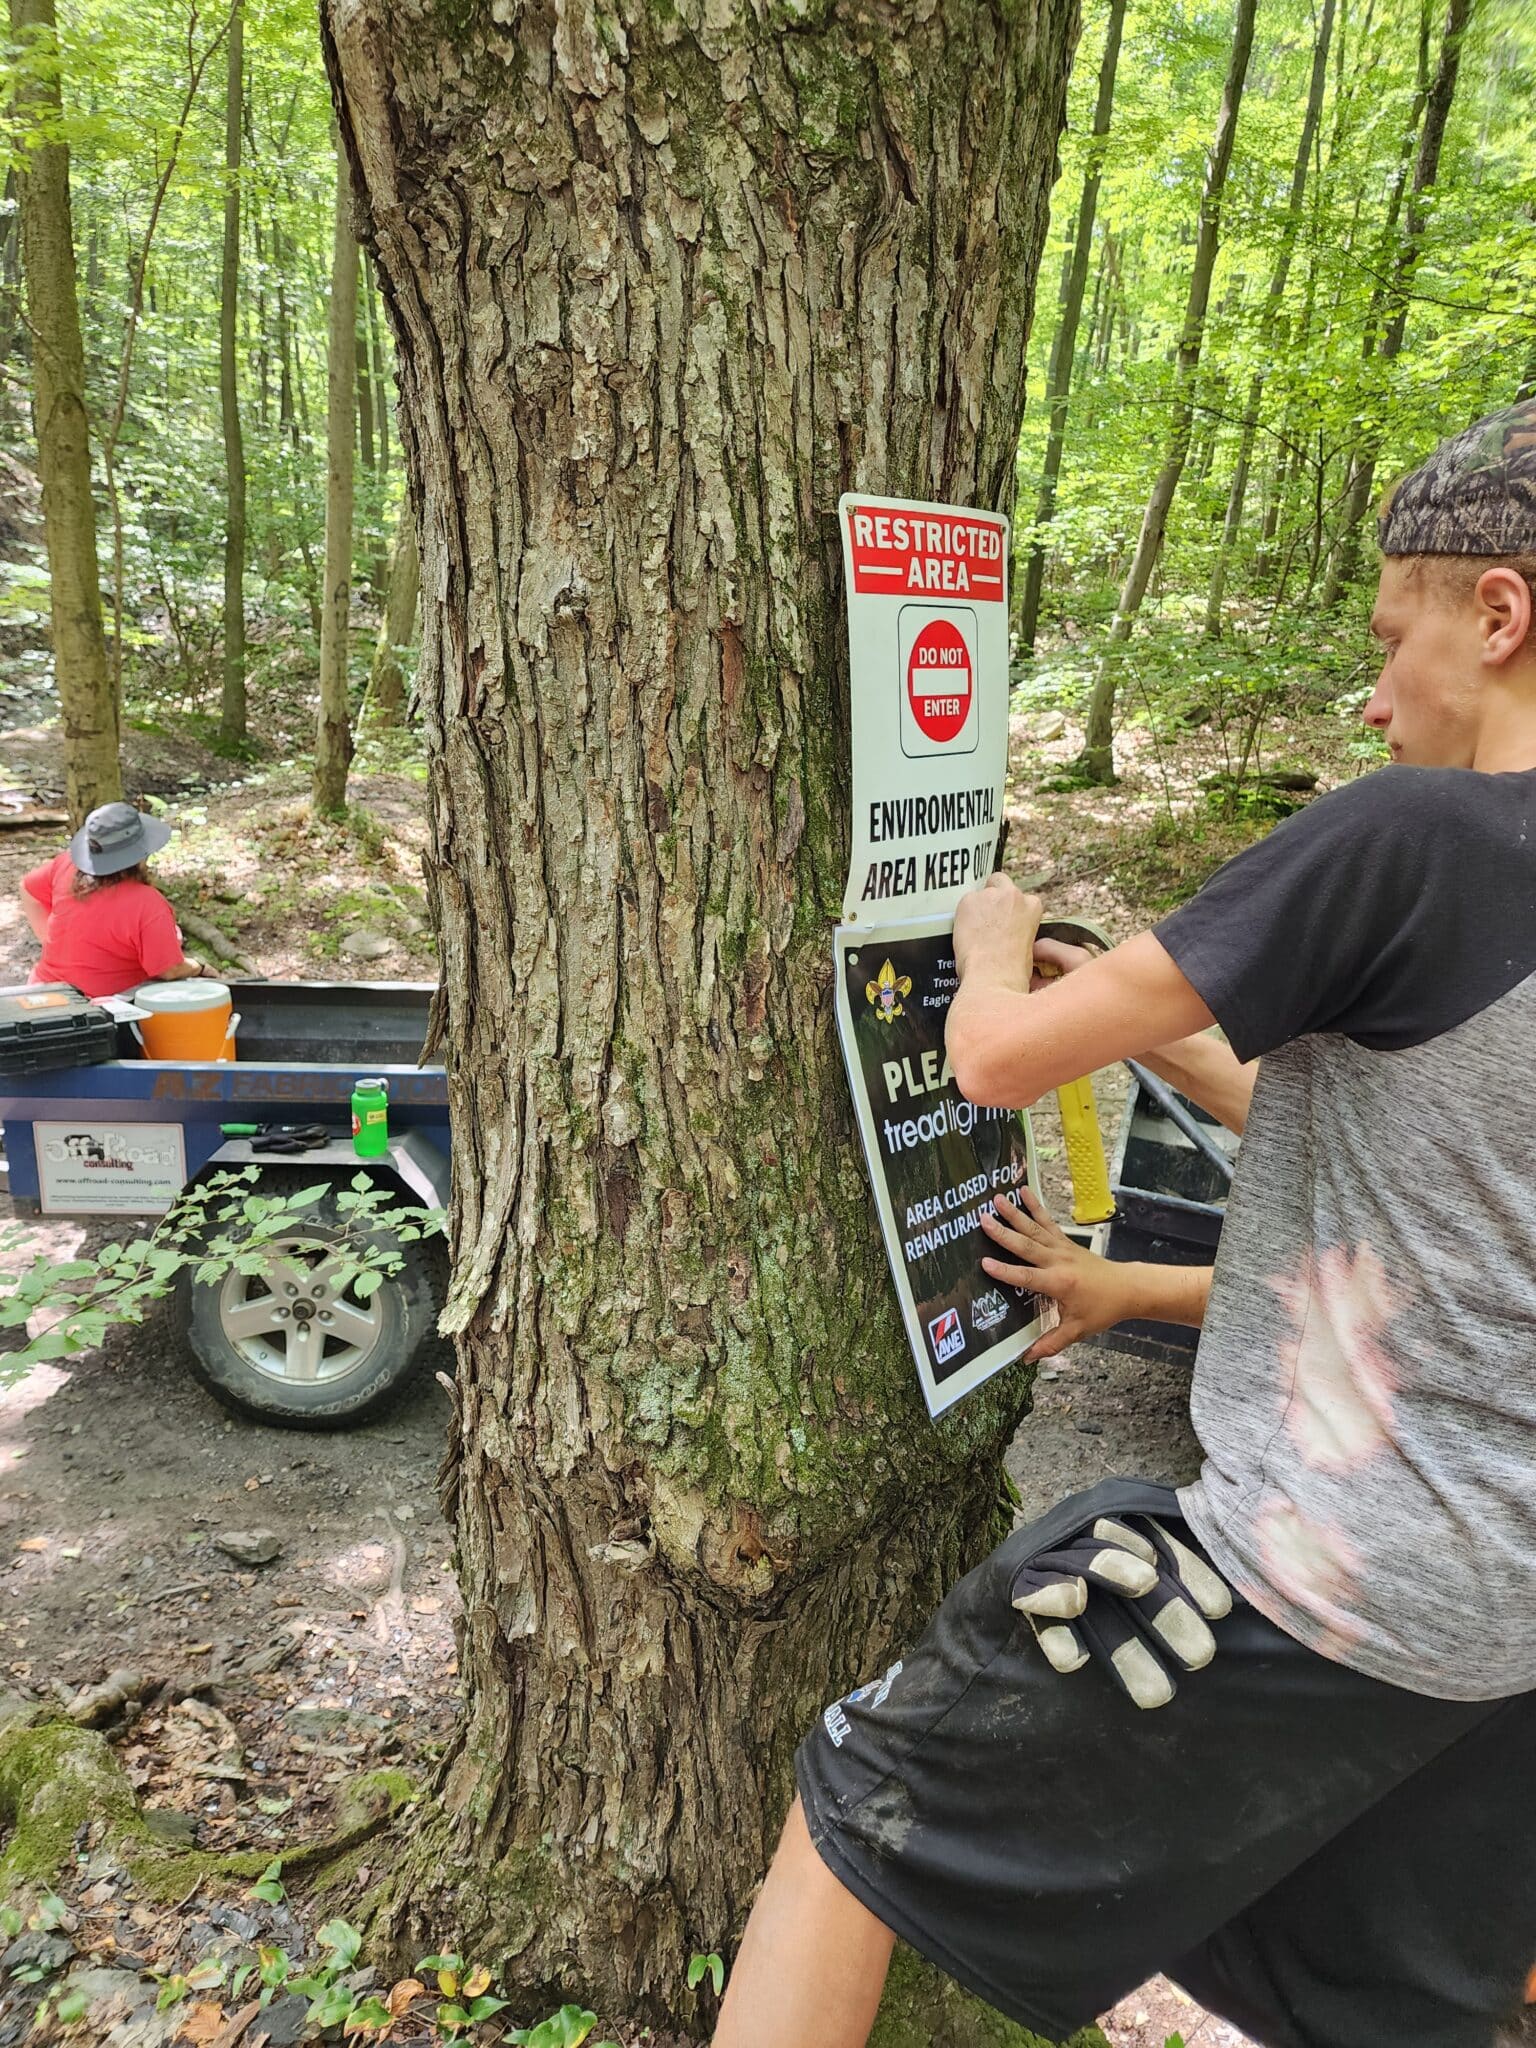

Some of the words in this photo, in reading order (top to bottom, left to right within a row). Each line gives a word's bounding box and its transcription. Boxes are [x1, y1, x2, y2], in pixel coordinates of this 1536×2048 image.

[854, 515, 1000, 560] RESTRICTED
[907, 557, 970, 592] AREA
[919, 647, 938, 665] DO
[940, 647, 963, 665] NOT
[924, 698, 960, 717] ENTER
[869, 787, 994, 843] ENVIROMENTAL
[861, 856, 916, 901] AREA
[924, 848, 970, 891] KEEP
[973, 840, 992, 881] OUT
[937, 959, 955, 970] Tre
[922, 993, 950, 1008] Eagle
[882, 1050, 956, 1104] PLEA
[83, 1158, 134, 1171] consulting
[906, 1195, 944, 1229] AREA
[944, 1173, 988, 1210] CLOSED
[992, 1162, 1018, 1189] FOR
